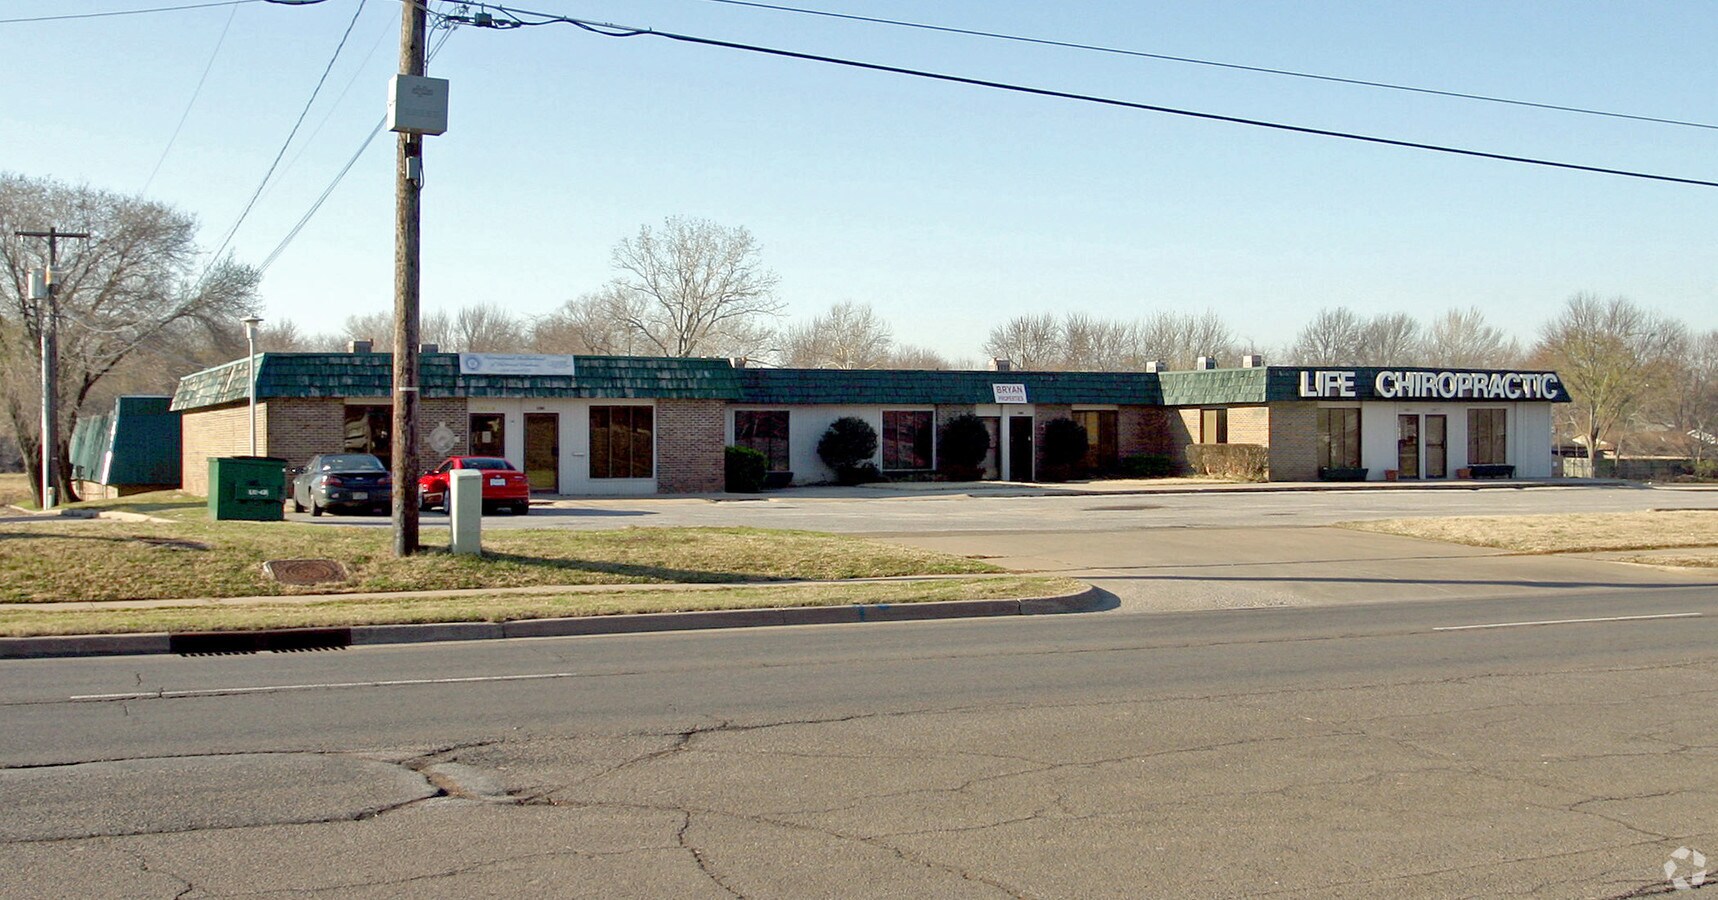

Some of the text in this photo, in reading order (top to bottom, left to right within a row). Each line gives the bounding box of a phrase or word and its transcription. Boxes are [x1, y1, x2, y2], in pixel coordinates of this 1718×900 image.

[996, 385, 1023, 394] BRYAN
[1299, 370, 1559, 400] LIFE CHIROPRACTIC
